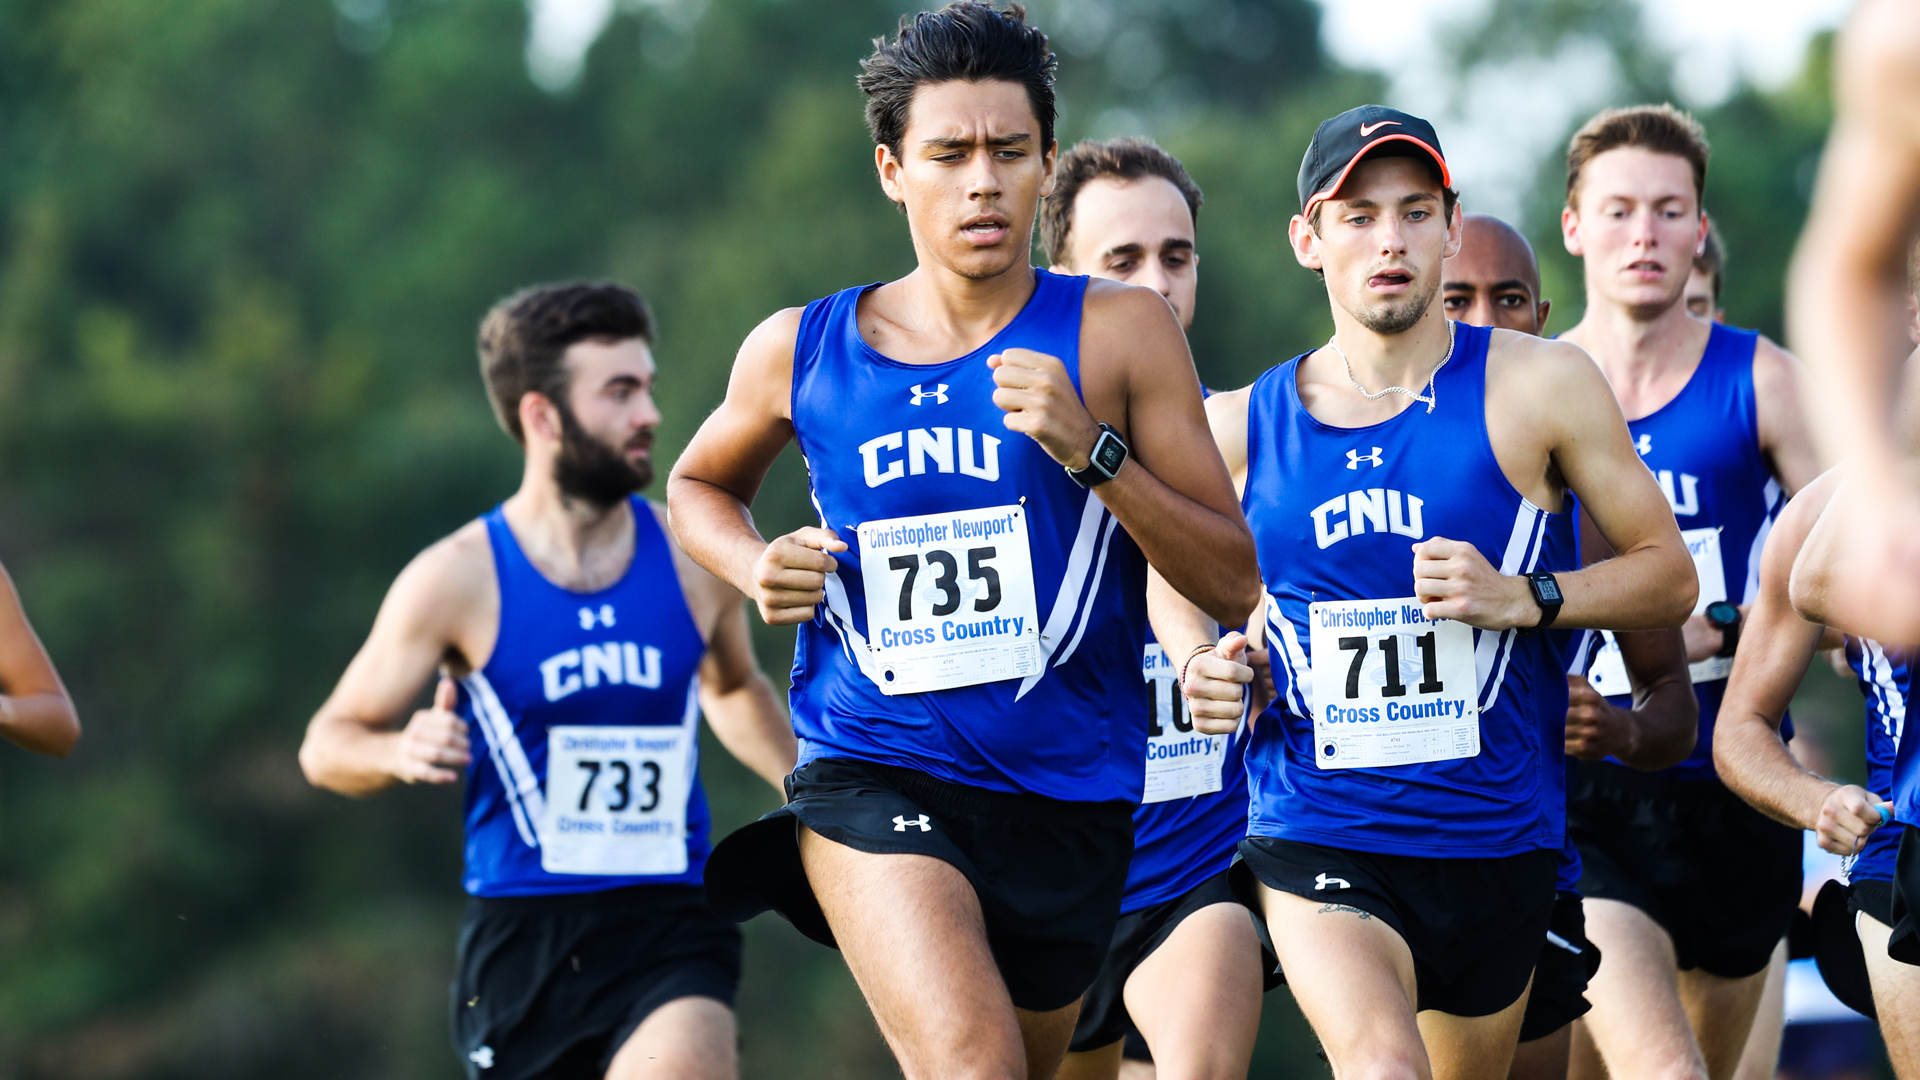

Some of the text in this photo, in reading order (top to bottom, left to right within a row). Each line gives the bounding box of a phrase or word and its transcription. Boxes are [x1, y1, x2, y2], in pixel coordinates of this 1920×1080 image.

[858, 427, 1001, 488] CNU
[870, 513, 1014, 549] Christopher Newport
[1310, 488, 1424, 550] CNU
[888, 546, 1002, 621] 735
[881, 627, 936, 648] Cross
[942, 616, 1024, 642] Country
[1321, 606, 1397, 630] Christopher
[539, 641, 662, 702] CNU
[1338, 631, 1444, 699] 711
[1147, 678, 1193, 737] 10
[1326, 698, 1466, 724] Cross Country
[1147, 737, 1212, 760] Country
[578, 760, 661, 811] 733
